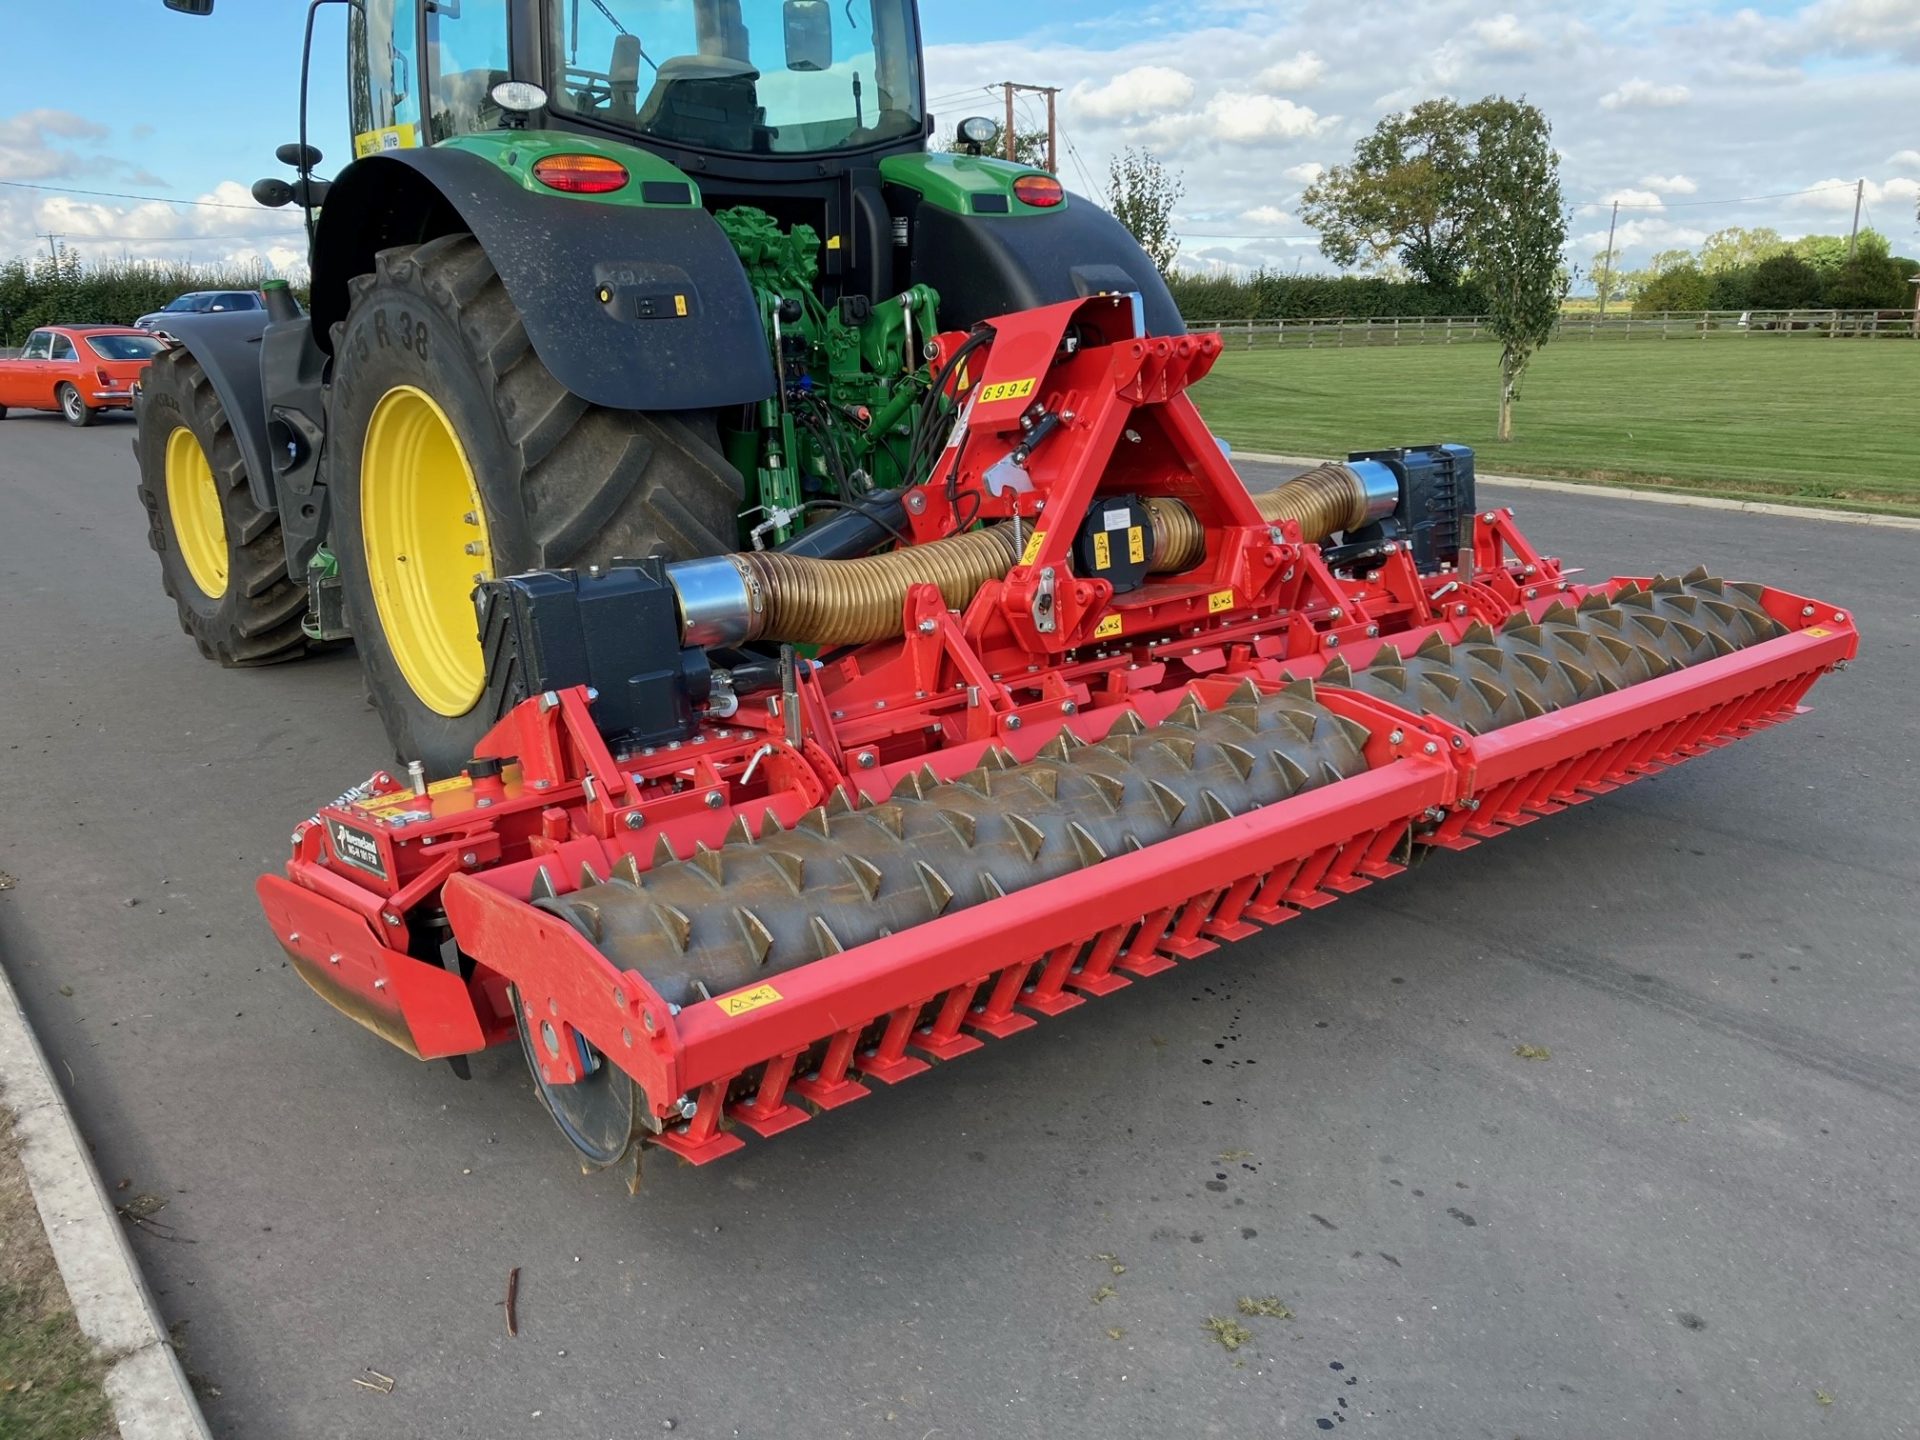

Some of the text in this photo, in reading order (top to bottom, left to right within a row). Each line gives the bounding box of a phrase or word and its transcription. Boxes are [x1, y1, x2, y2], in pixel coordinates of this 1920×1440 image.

[383, 134, 398, 149] Hire
[399, 311, 428, 362] 38
[982, 380, 1031, 400] 6994
